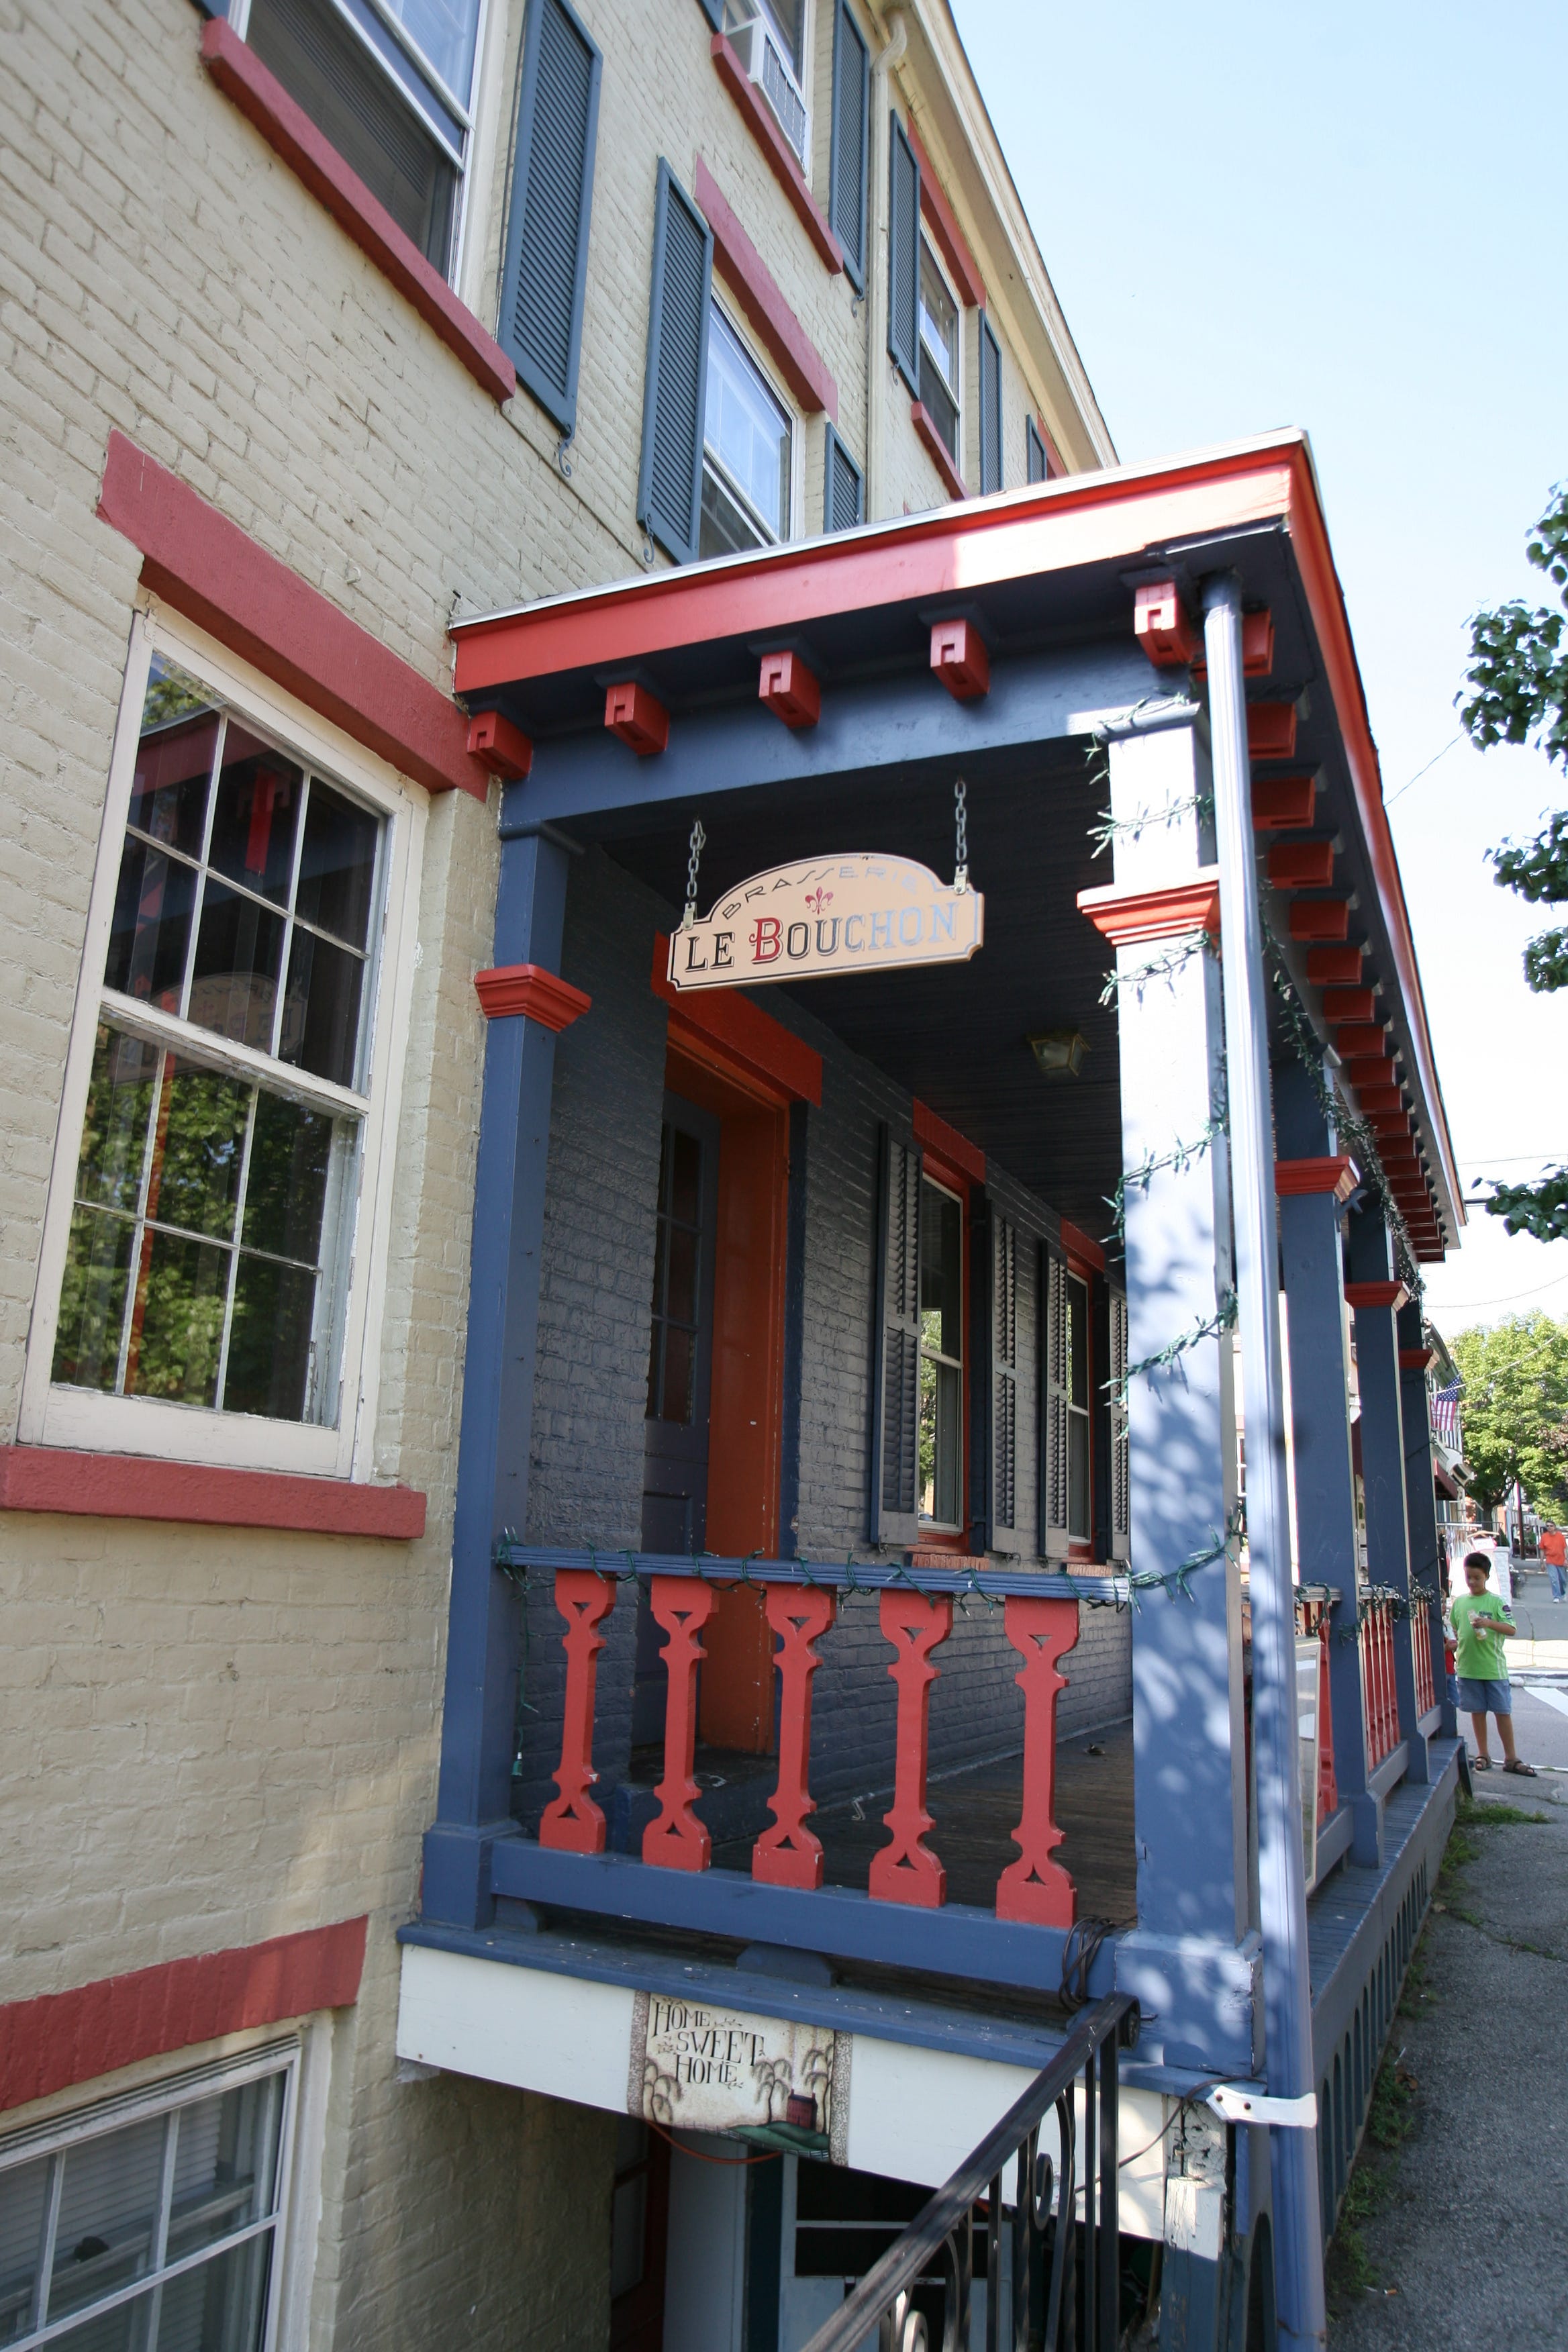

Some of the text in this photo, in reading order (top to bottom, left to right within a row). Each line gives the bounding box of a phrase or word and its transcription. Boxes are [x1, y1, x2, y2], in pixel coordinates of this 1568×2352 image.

[722, 866, 919, 920] BRASSERIE
[685, 901, 961, 973] LE BOUCHON
[651, 2002, 712, 2038] HOME
[676, 2030, 765, 2067] SWEET
[675, 2054, 739, 2084] HOME
